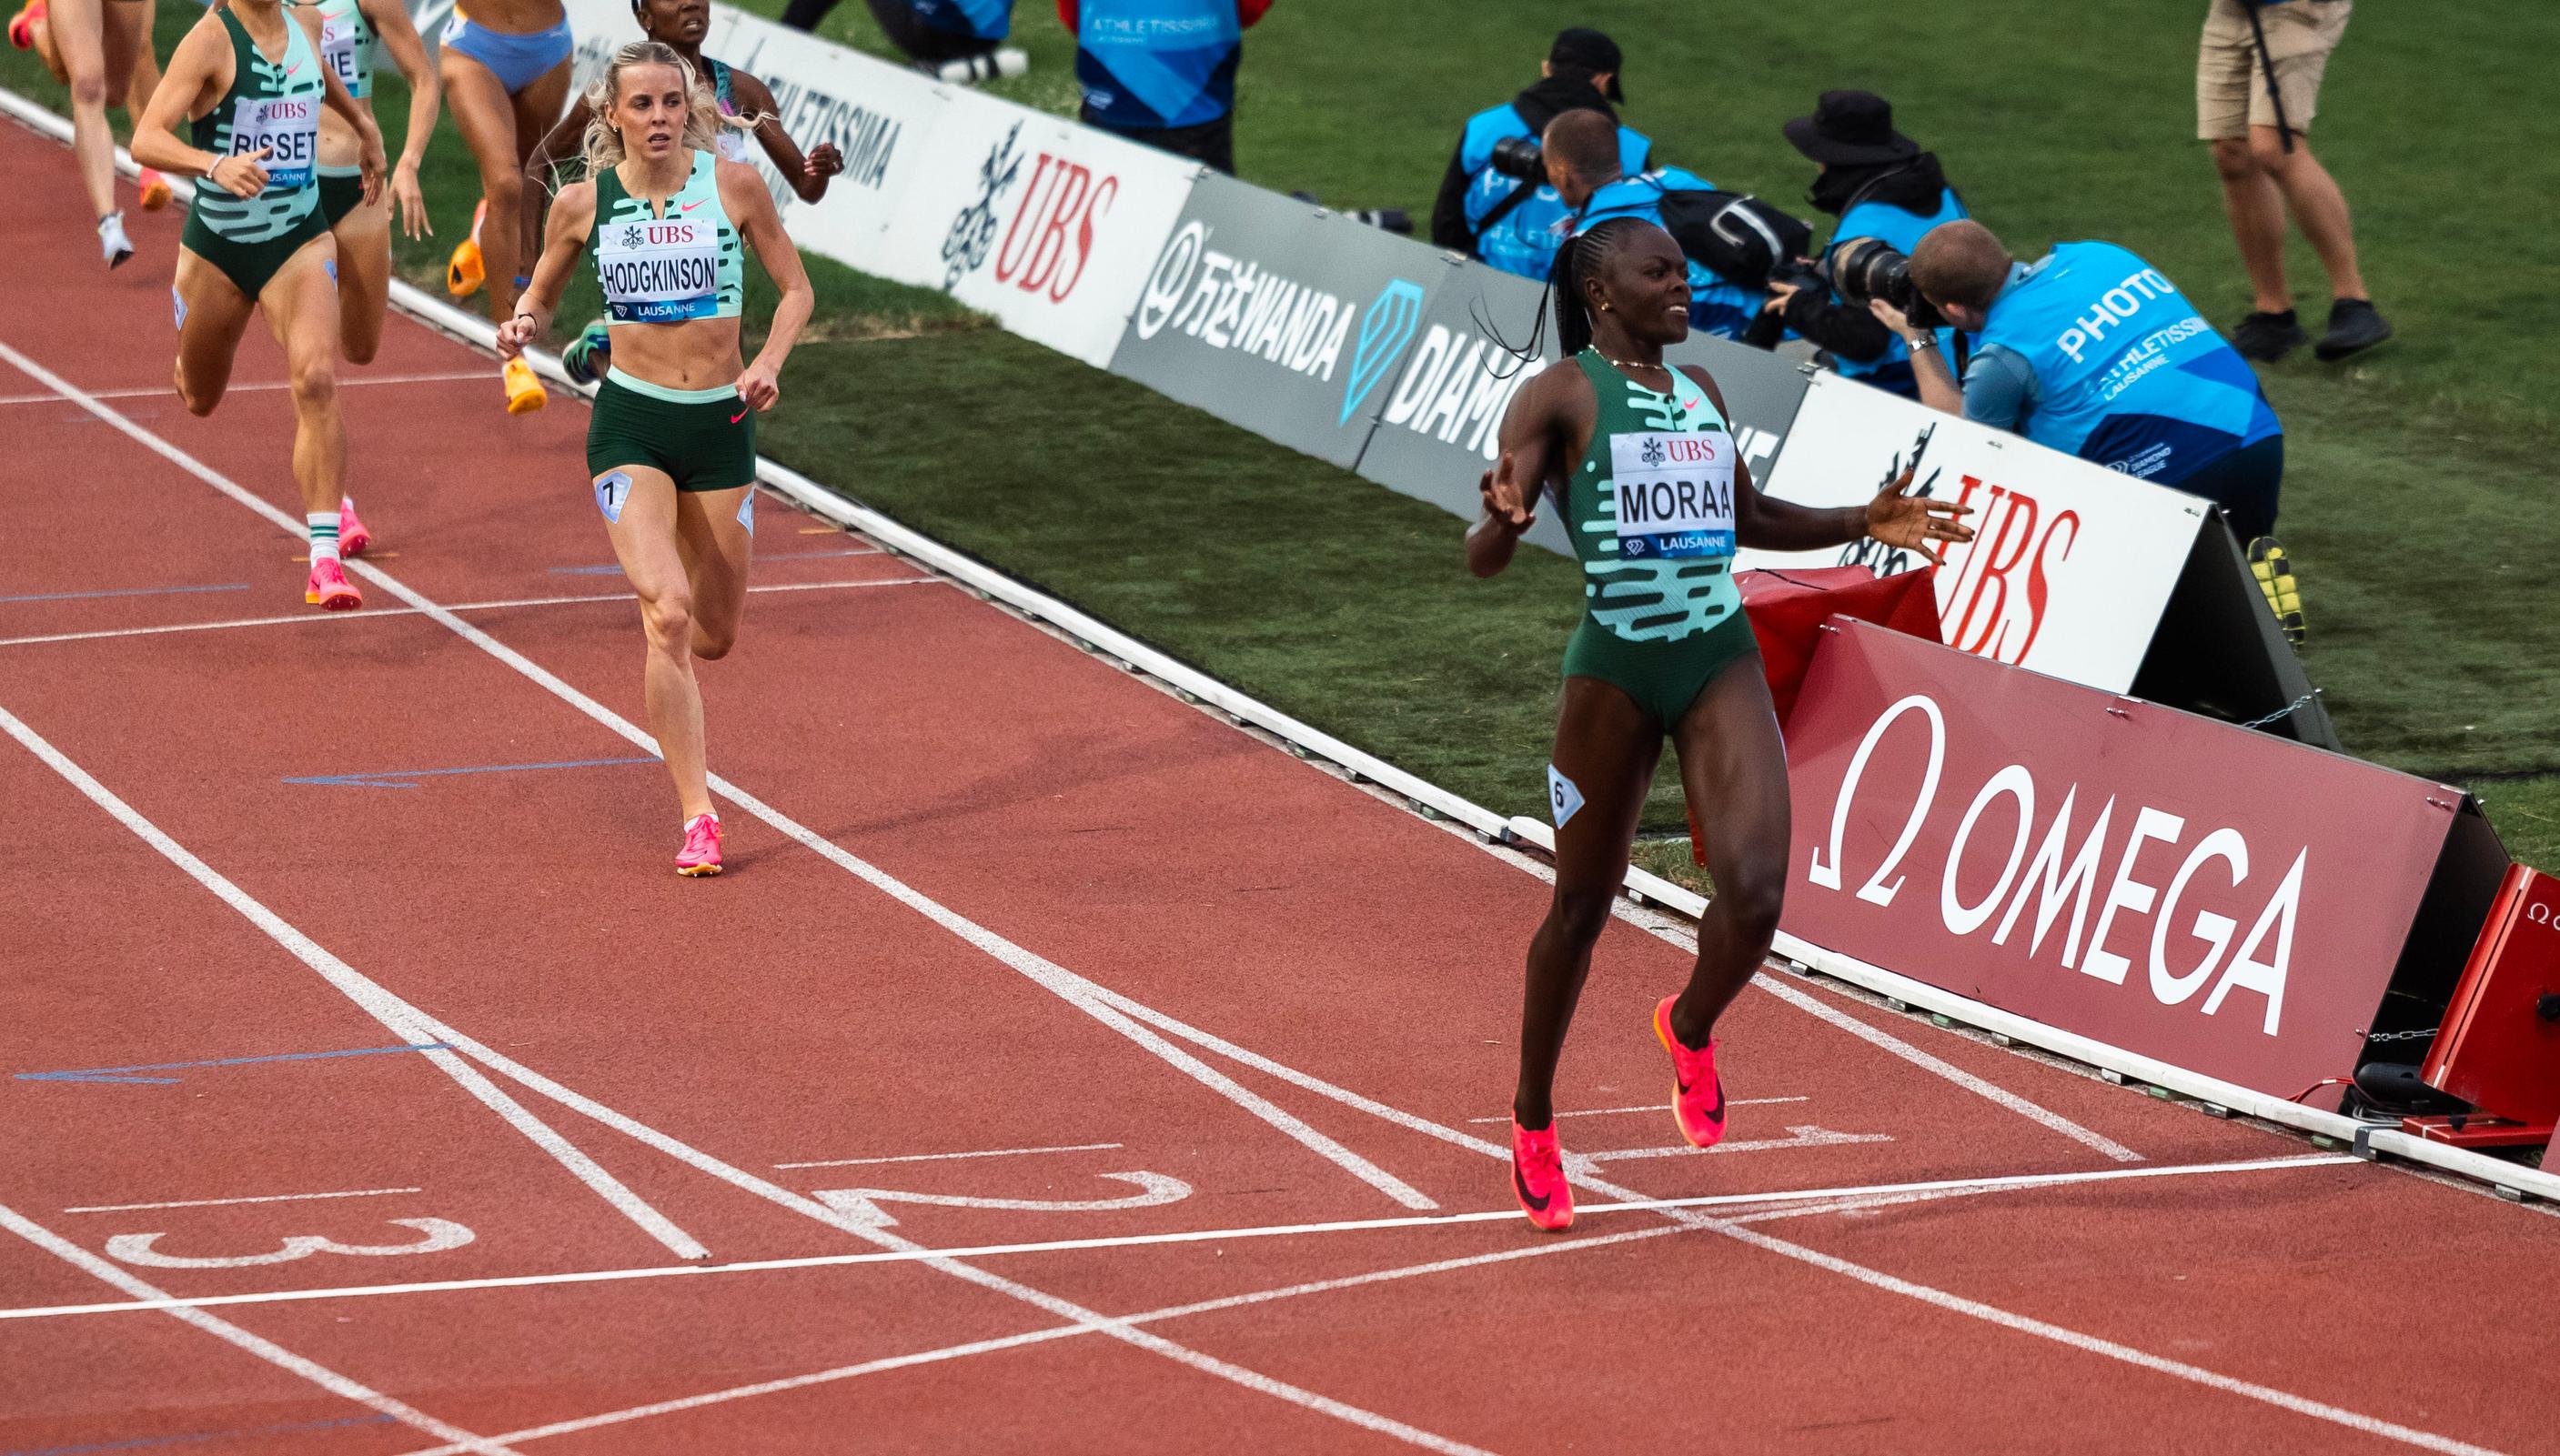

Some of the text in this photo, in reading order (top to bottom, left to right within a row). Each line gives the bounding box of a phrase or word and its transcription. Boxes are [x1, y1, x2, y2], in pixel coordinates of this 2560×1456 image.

[272, 102, 307, 120] UBS
[647, 225, 694, 245] UBS
[994, 152, 1118, 305] UBS
[602, 256, 716, 295] HODGKINSON
[638, 306, 696, 316] LAUSANNE
[1231, 271, 1356, 382] WANDA
[2056, 267, 2175, 365] PHOTO
[2103, 353, 2171, 401] LAUSANNE
[1667, 438, 1716, 463] UBS
[1620, 480, 1733, 525] MORAA
[1659, 536, 1727, 551] LAUSANNE
[1930, 473, 2081, 667] UBS
[1555, 781, 1565, 808] 6
[1940, 764, 2308, 1037] OMEGA
[809, 1170, 1194, 1228] 2
[106, 1216, 476, 1269] 3
